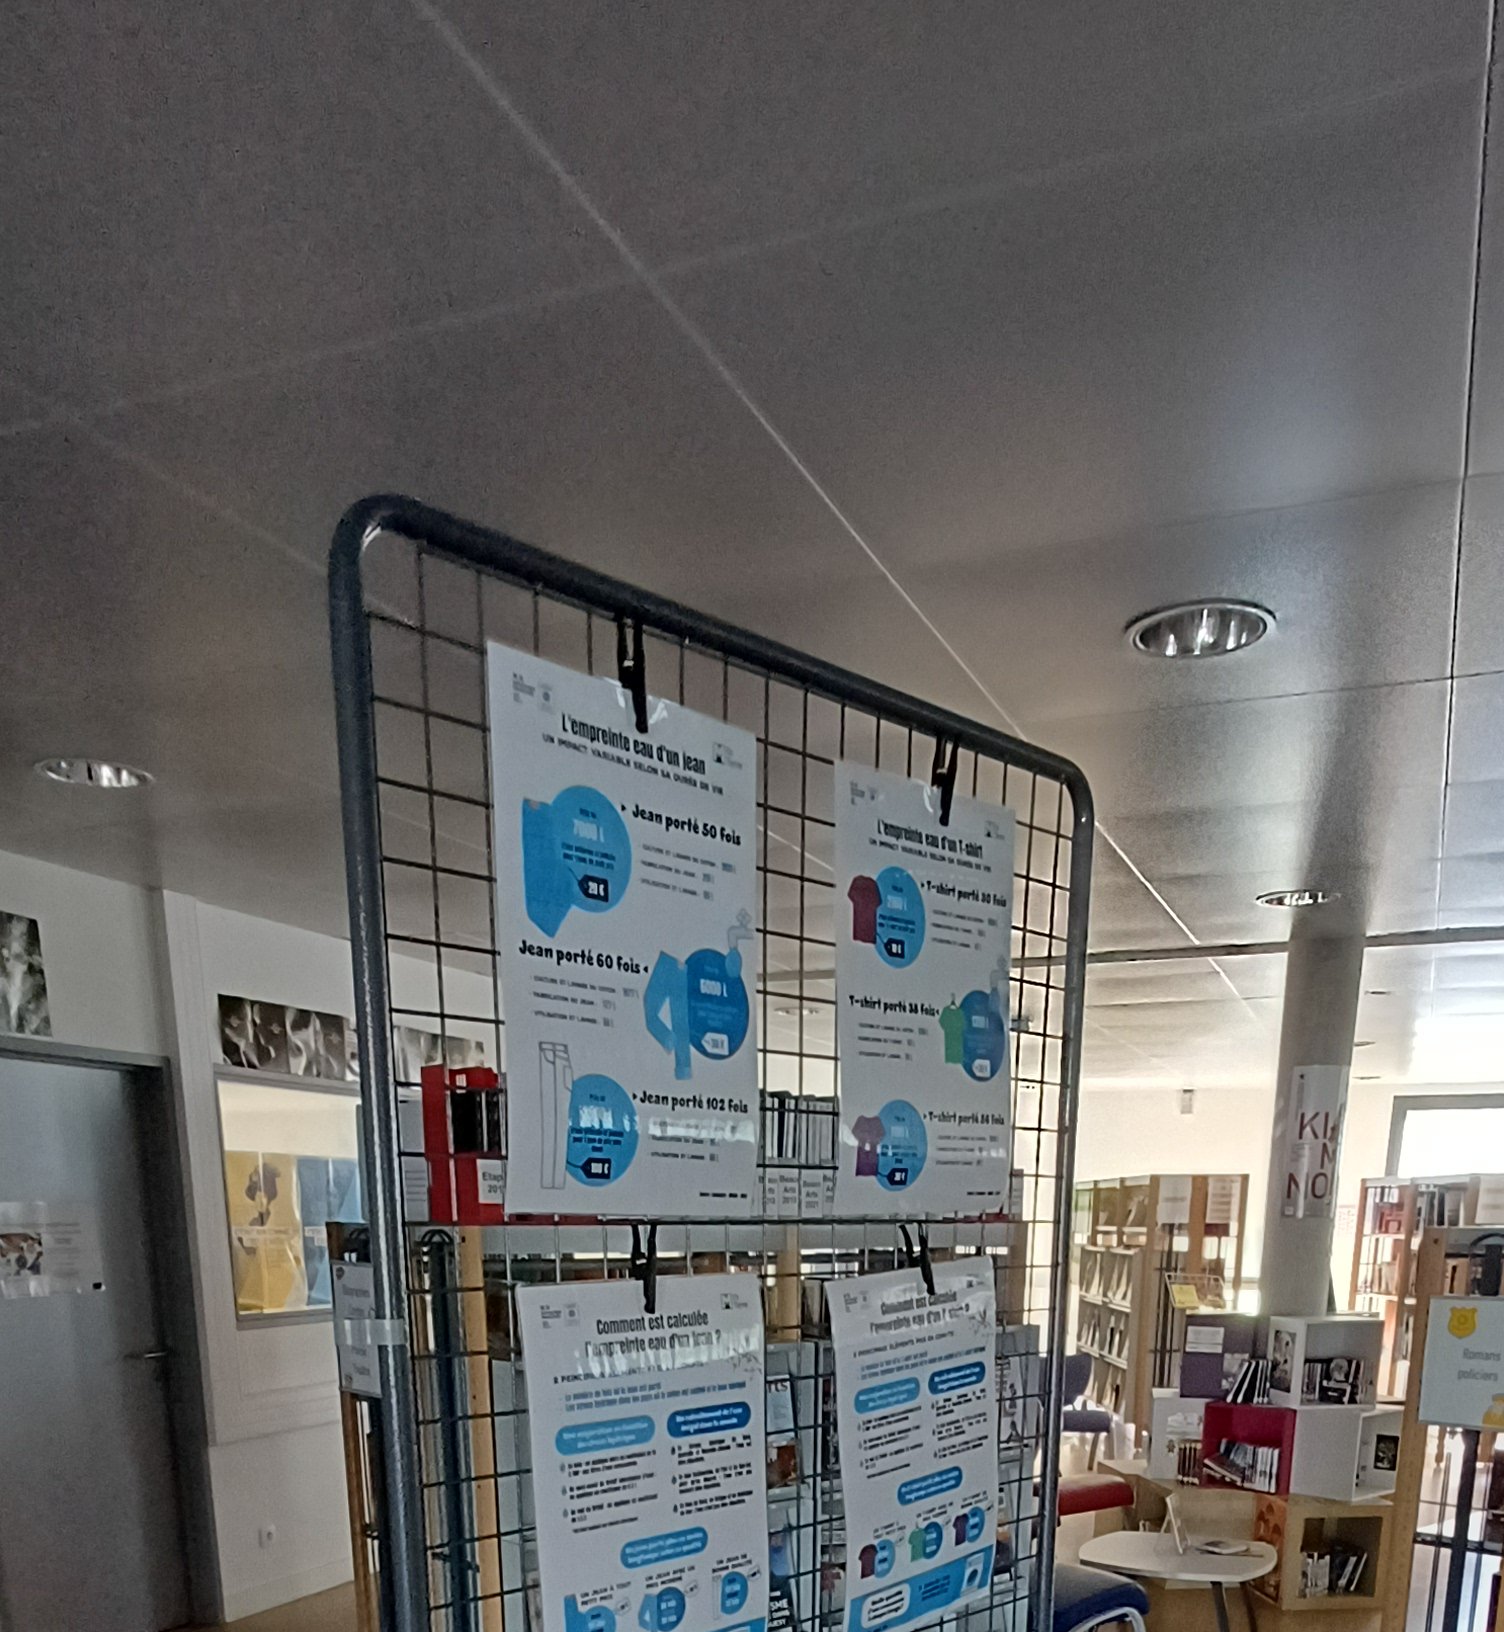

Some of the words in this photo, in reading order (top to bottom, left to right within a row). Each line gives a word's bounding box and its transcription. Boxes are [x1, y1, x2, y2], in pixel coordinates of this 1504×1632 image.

[562, 712, 630, 752] L'empreinte
[633, 739, 653, 759] eau
[657, 744, 679, 767] d'un
[682, 750, 705, 775] jean
[632, 804, 662, 824] Jean
[665, 815, 699, 834] porté
[702, 823, 717, 839] 50
[720, 826, 741, 846] fois
[927, 880, 956, 897] T-shirt
[519, 940, 554, 959] Jean
[556, 948, 594, 967] porté
[597, 953, 614, 970] 60
[617, 956, 640, 975] fois
[849, 995, 881, 1010] T-shirt
[883, 999, 907, 1015] porté
[640, 1090, 668, 1107] Jean
[671, 1094, 703, 1111] porté
[706, 1099, 726, 1112] 102
[728, 1099, 748, 1114] fois
[928, 1110, 957, 1123] T-shirt
[596, 1316, 646, 1335] Comment
[649, 1314, 665, 1331] est
[667, 1309, 708, 1329] calculée
[648, 1337, 666, 1351] eau
[1463, 1347, 1501, 1362] Romans
[1457, 1369, 1499, 1382] policiers
